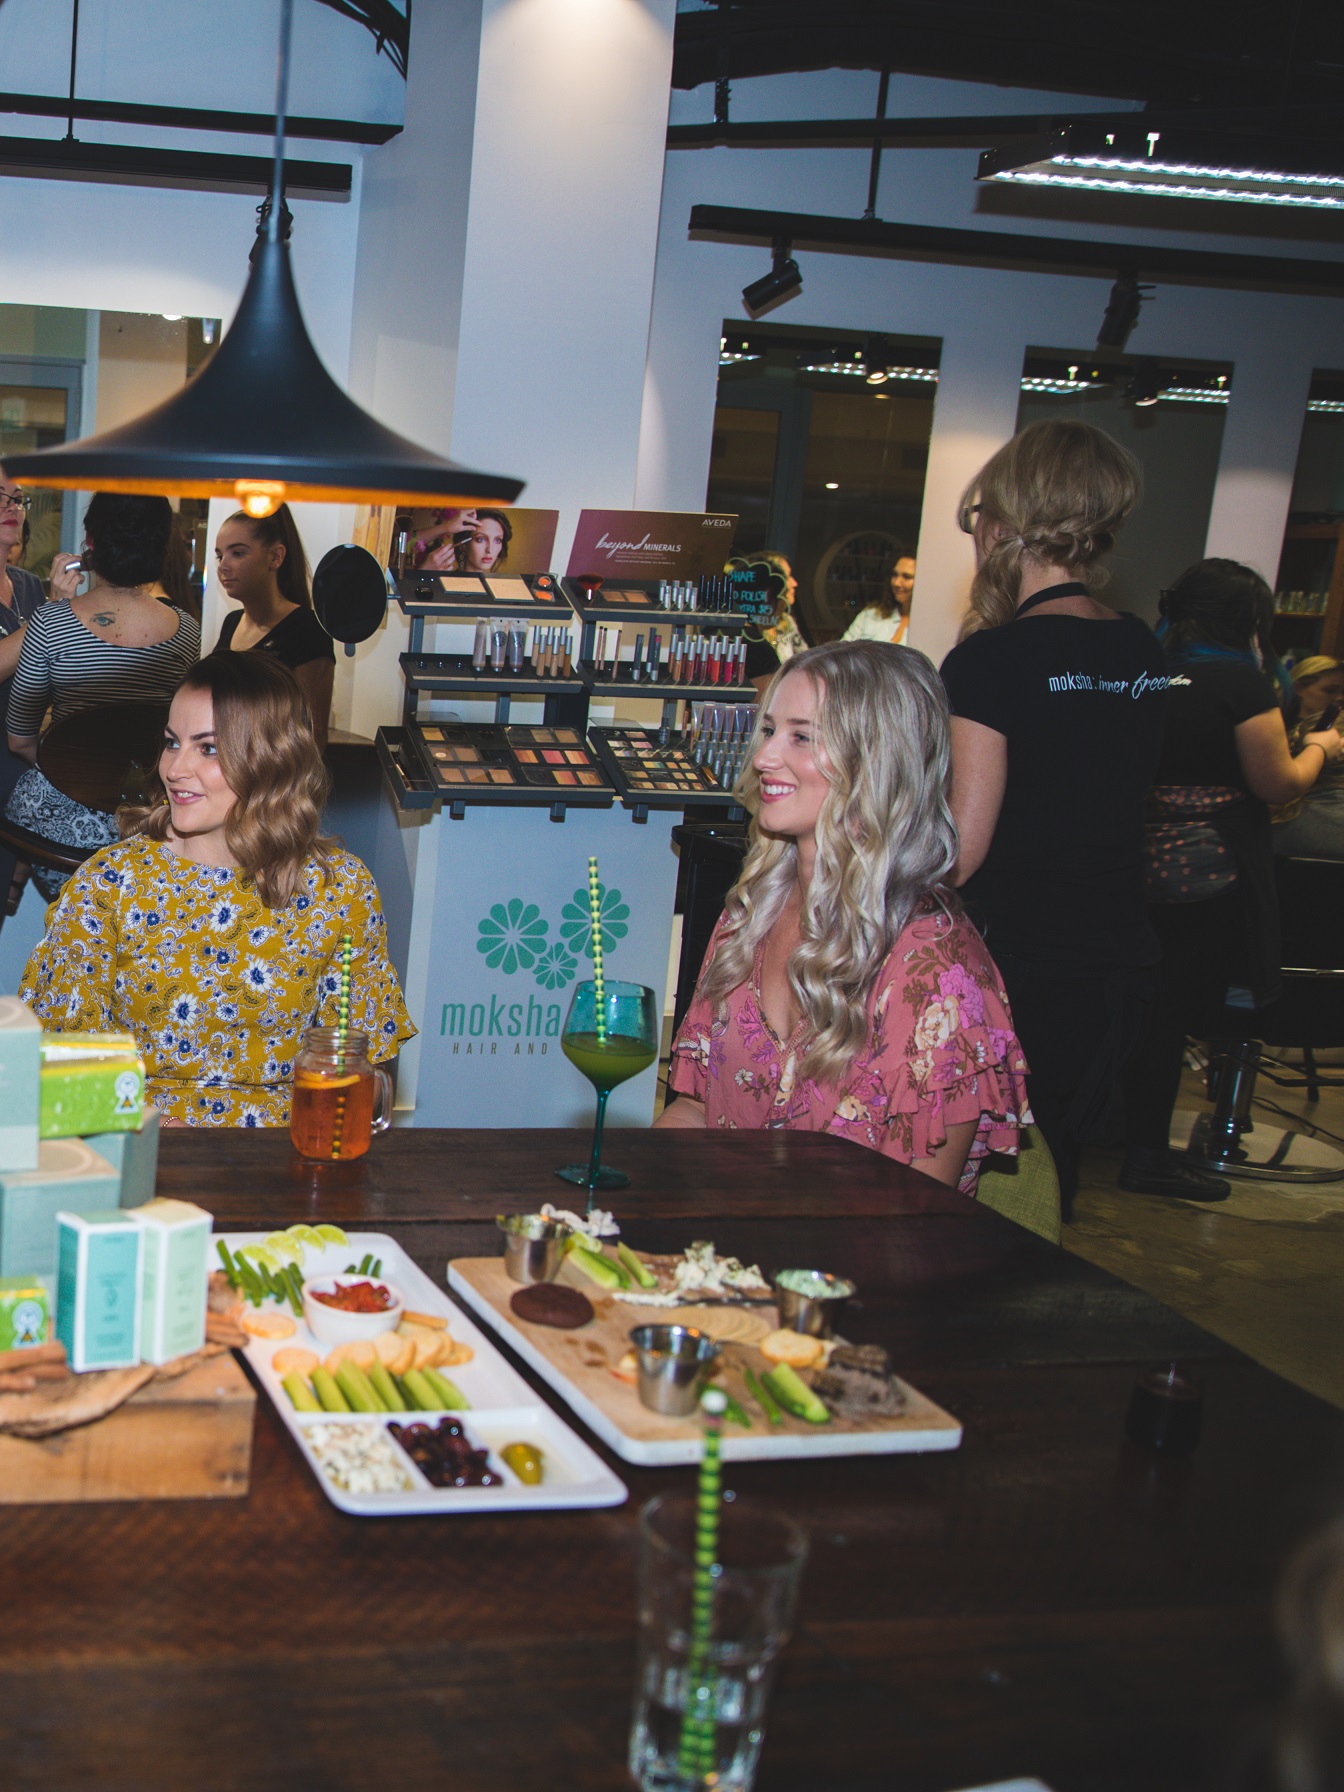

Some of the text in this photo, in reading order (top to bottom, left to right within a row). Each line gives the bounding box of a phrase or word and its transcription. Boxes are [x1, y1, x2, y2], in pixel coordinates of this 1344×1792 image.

[701, 518, 732, 528] AVEDA
[595, 532, 682, 560] beyond MINERALS
[739, 603, 756, 613] XTRA
[439, 993, 562, 1038] moksha
[452, 1041, 548, 1056] HAIR AND
